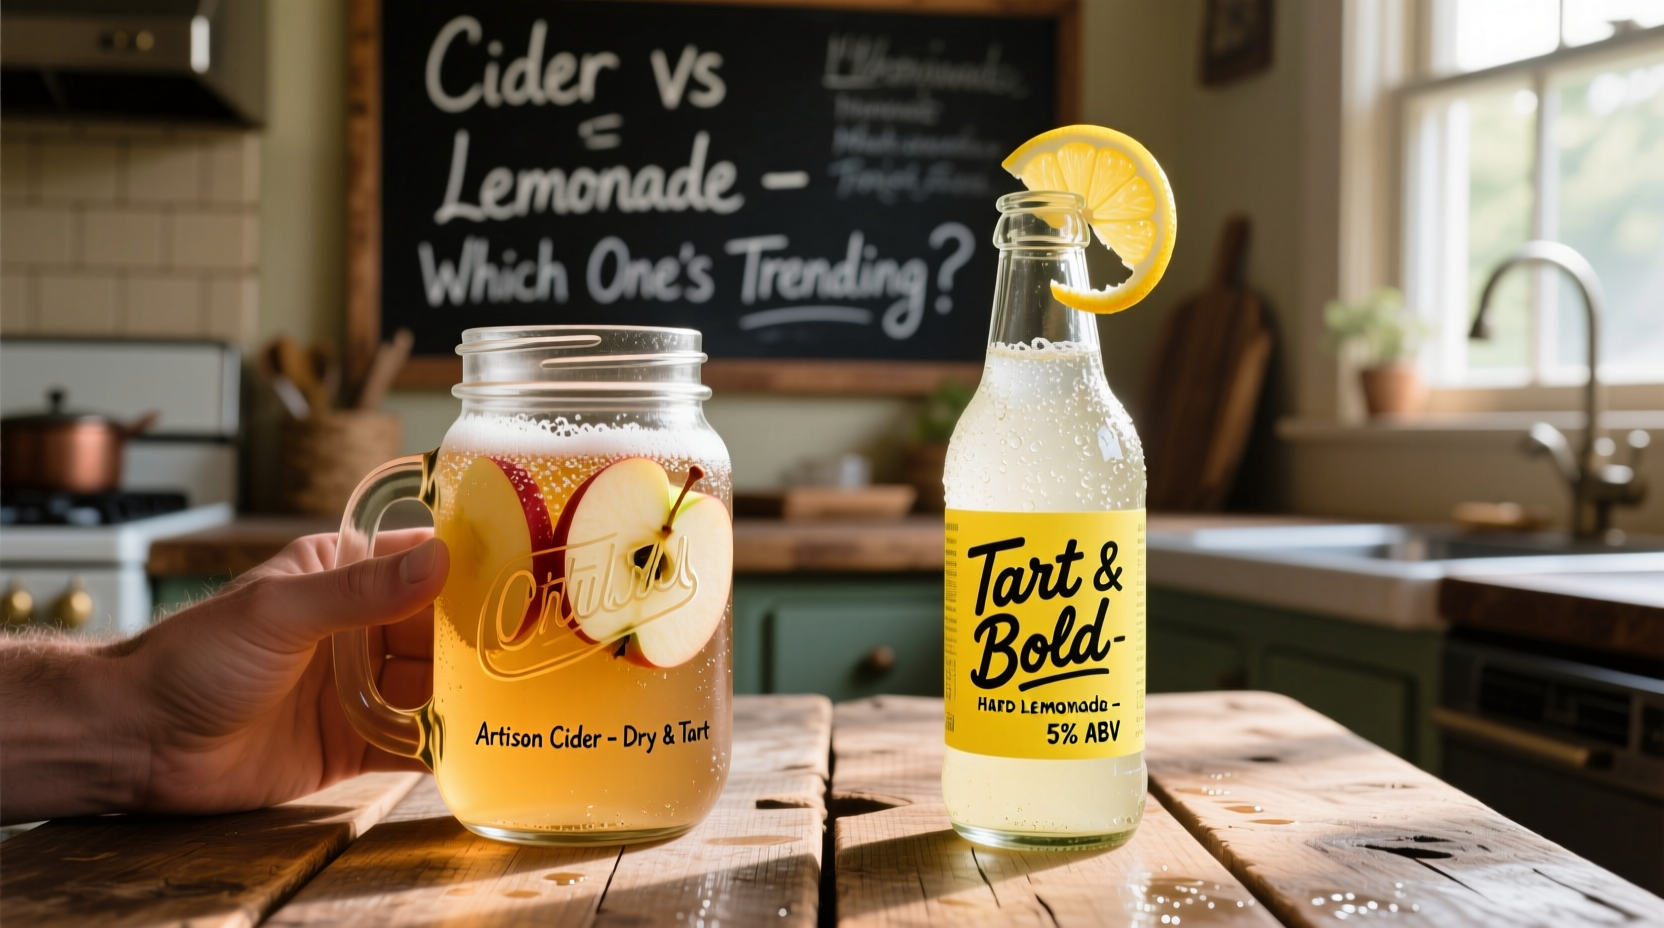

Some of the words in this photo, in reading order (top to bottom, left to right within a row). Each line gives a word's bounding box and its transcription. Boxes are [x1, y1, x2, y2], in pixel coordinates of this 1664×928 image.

[425, 15, 620, 113] Cider
[651, 44, 727, 110] vs
[433, 130, 745, 225] Lemonade
[418, 235, 569, 307] Which
[586, 236, 714, 304] One's
[725, 221, 975, 339] Trending?
[967, 536, 1084, 617] Tart
[1093, 540, 1123, 592] &
[475, 721, 543, 748] Artison
[550, 725, 602, 749] Cider
[623, 725, 657, 754] Dry
[662, 724, 675, 745] &
[678, 720, 710, 743] Tart
[1047, 723, 1078, 745] 5%
[1084, 720, 1121, 743] ABV
